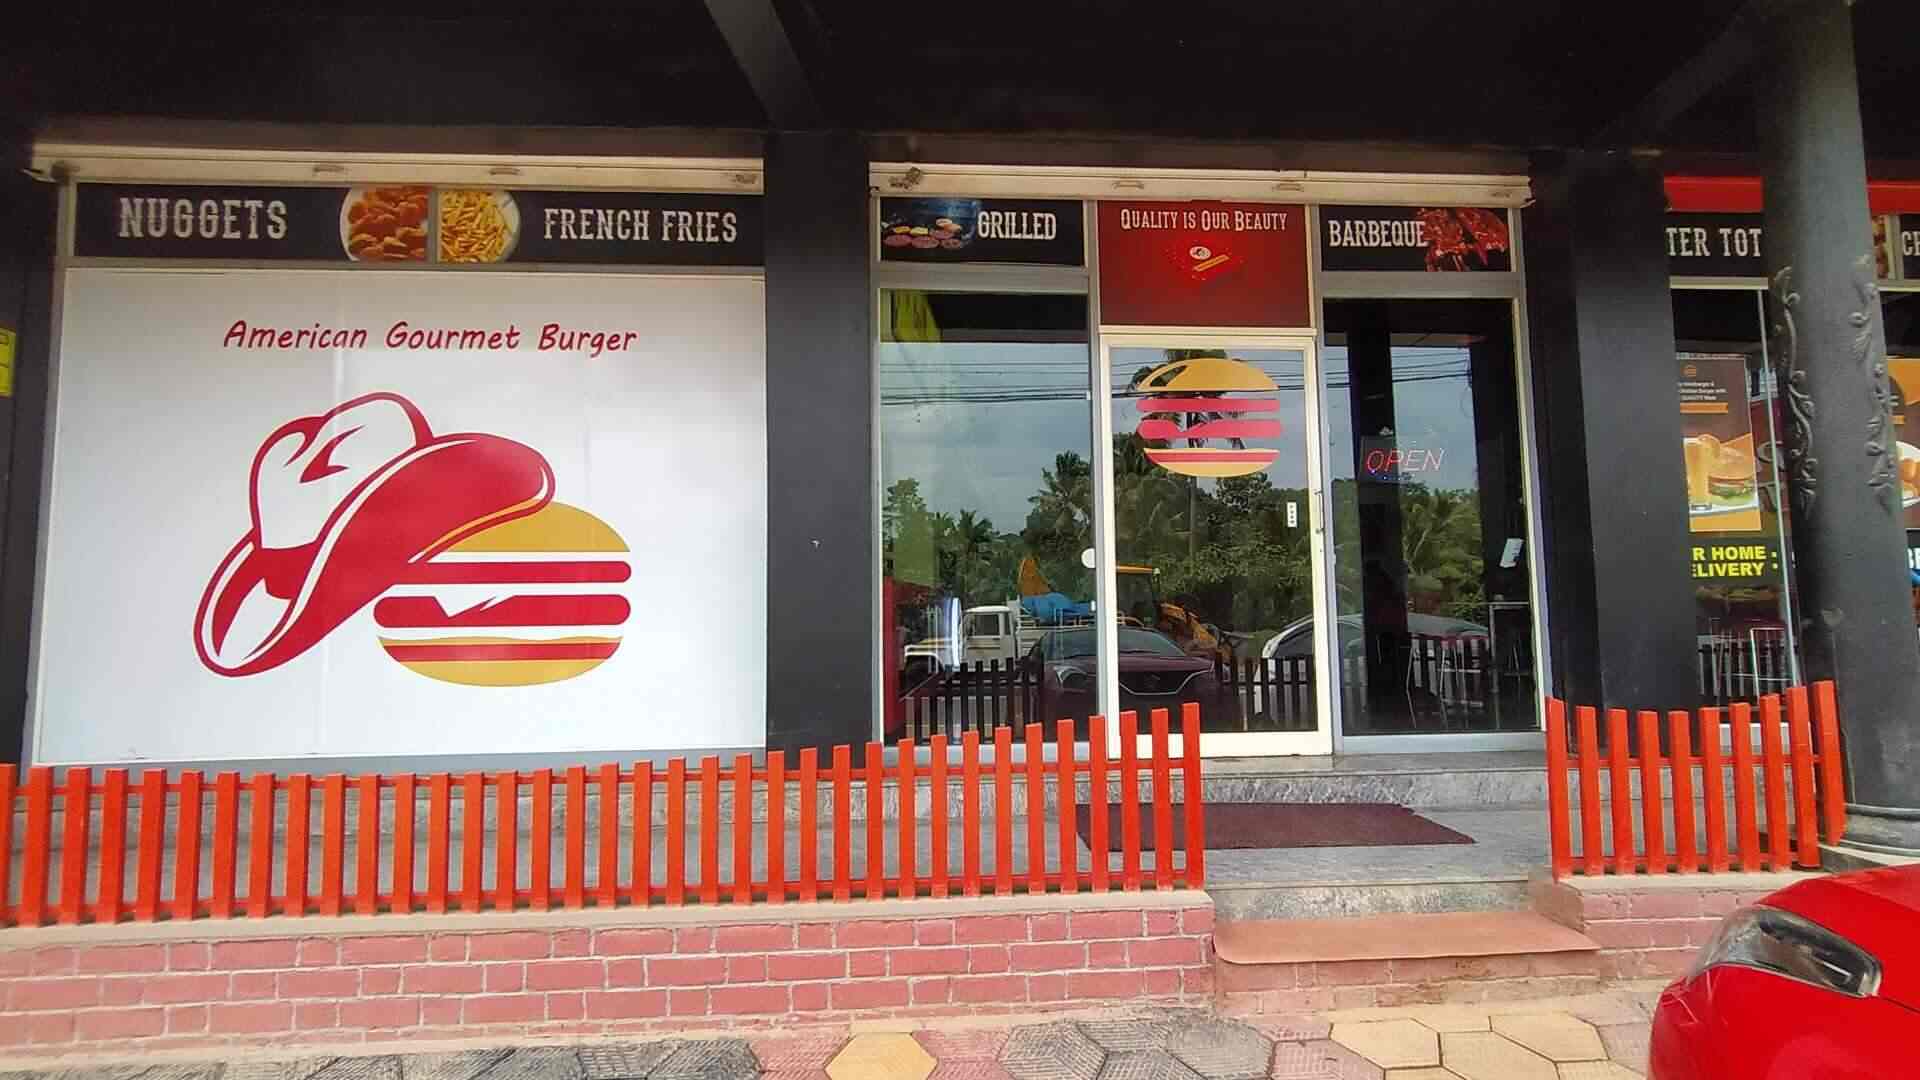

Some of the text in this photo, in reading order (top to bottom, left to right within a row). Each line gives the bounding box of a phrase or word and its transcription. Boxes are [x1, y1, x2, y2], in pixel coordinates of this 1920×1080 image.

[118, 197, 288, 240] NUGGETS
[543, 207, 737, 243] FRENCH FRIES
[977, 210, 1057, 240] GRILLED
[1327, 219, 1430, 248] BARBEQUE
[223, 319, 638, 358] American Gourmet Burger
[1367, 448, 1445, 472] OPEN
[1711, 546, 1767, 560] HOME
